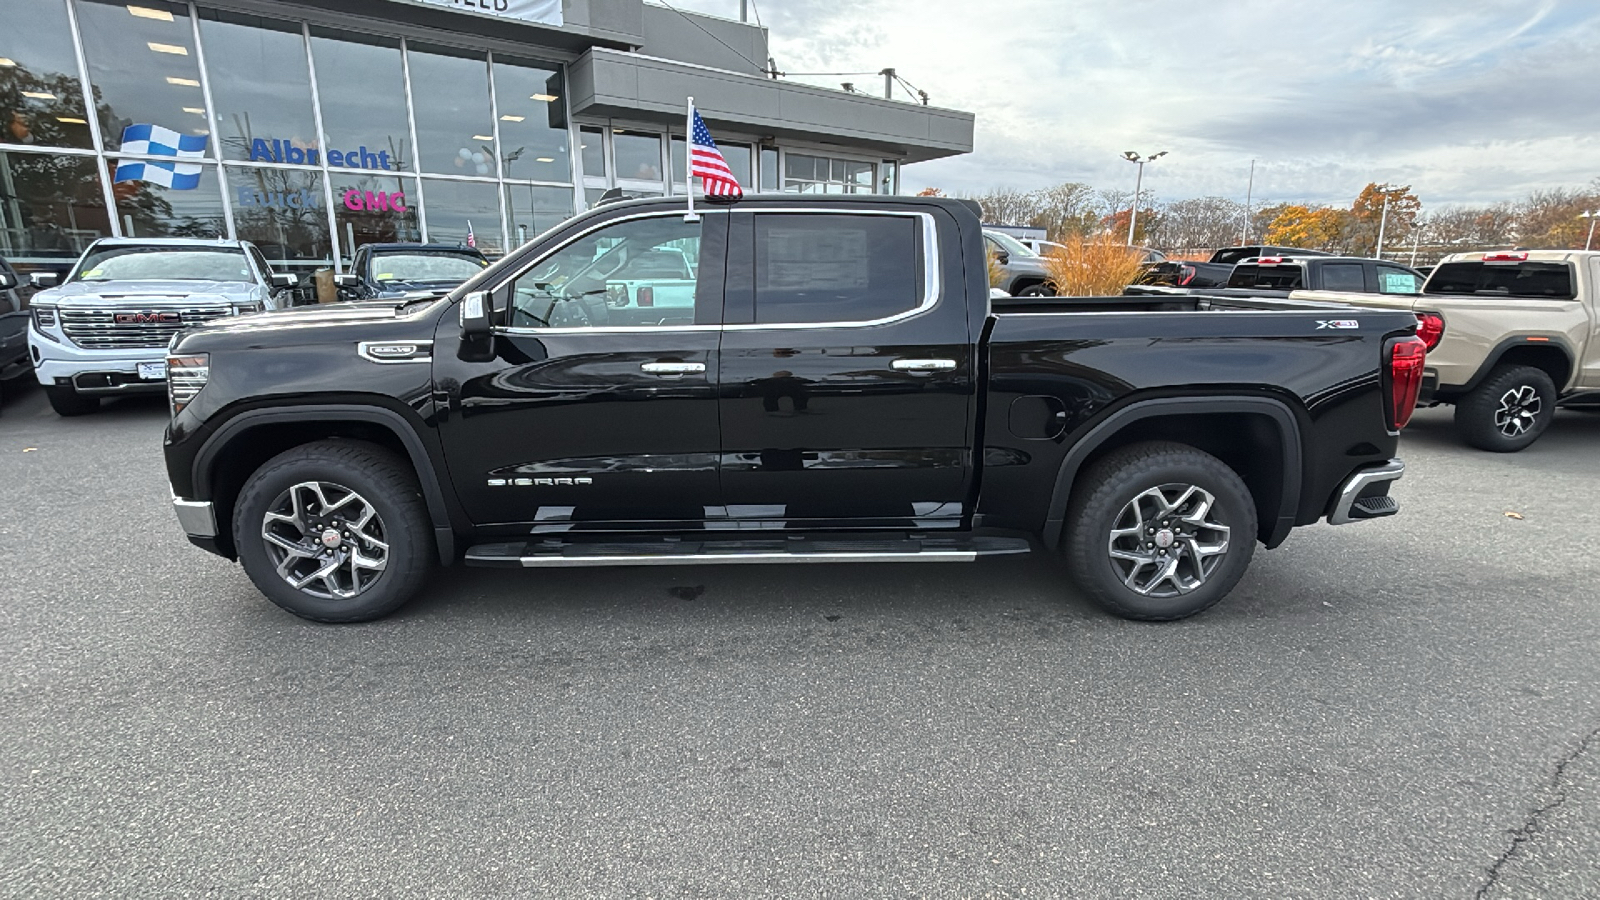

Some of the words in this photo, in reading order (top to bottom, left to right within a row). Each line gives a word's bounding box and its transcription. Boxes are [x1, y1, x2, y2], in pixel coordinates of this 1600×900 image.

[250, 137, 391, 170] Albrecht
[238, 185, 319, 209] Buick
[344, 189, 407, 213] GMC
[116, 313, 180, 324] GMC
[487, 477, 593, 486] SIERRA
